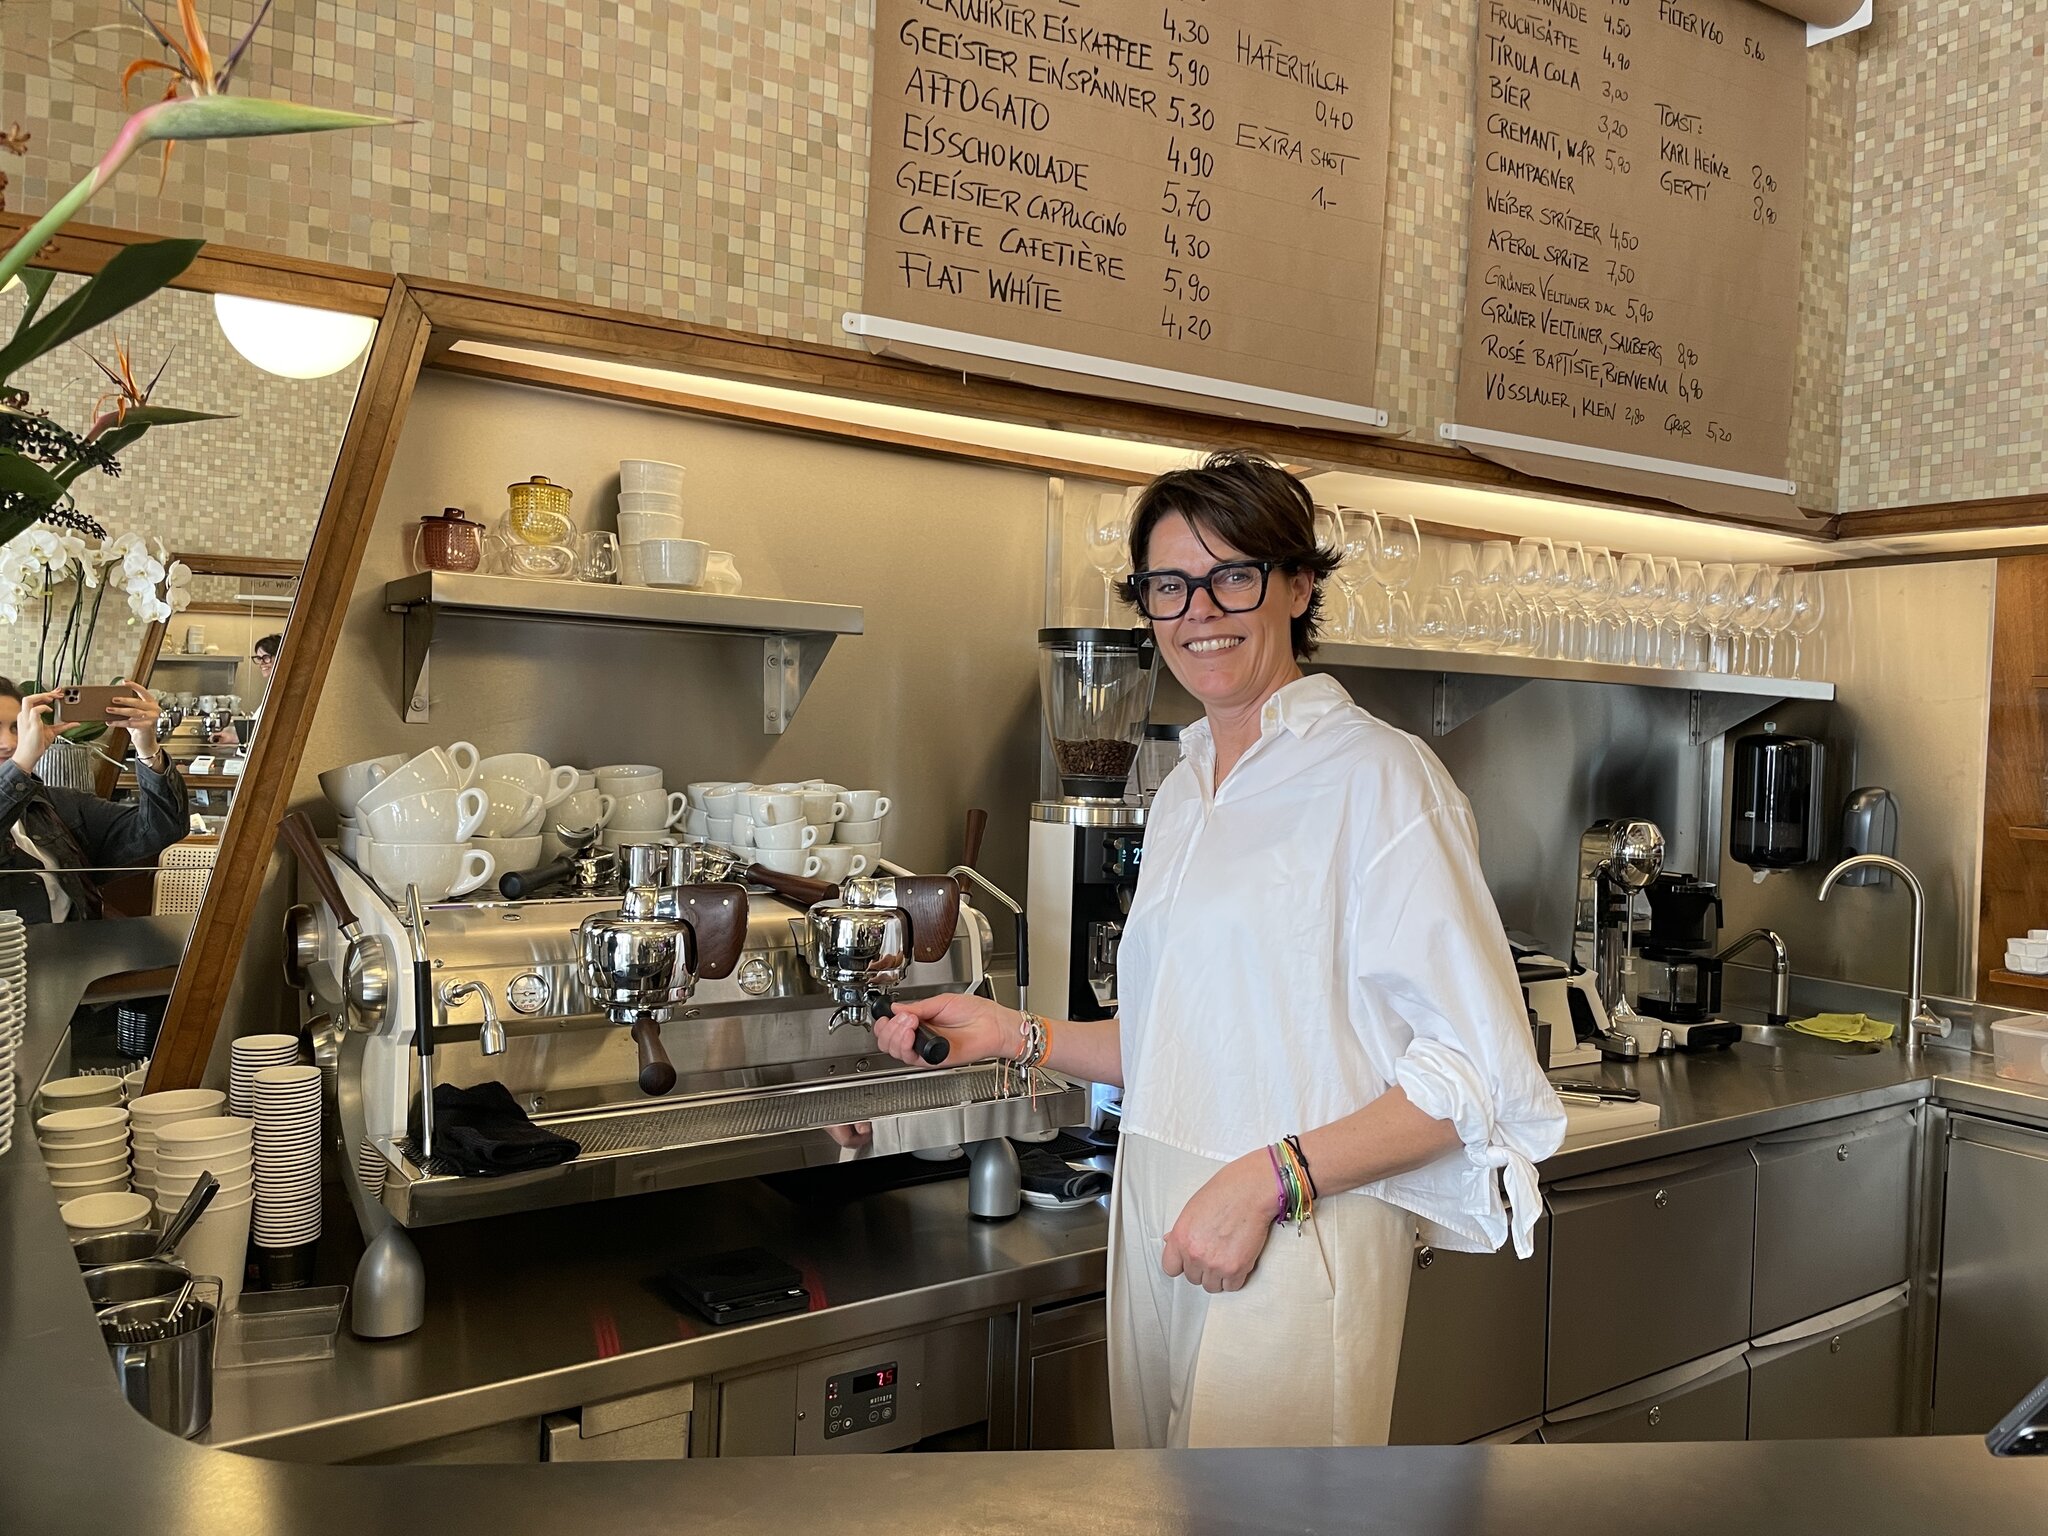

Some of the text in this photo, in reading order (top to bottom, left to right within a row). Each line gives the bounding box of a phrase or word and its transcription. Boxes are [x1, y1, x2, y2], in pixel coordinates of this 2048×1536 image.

[1043, 14, 1154, 71] EISKAFFEE
[1168, 51, 1210, 86] 5,90
[1163, 8, 1209, 45] 4,30
[1658, 0, 1698, 35] FILTER
[1700, 18, 1724, 45] V60
[899, 19, 1017, 78] GEEISTER
[1167, 96, 1215, 131] 5,30
[1237, 29, 1349, 95] HAFERMILCH
[1485, 35, 1539, 80] TIROLA
[1544, 62, 1581, 91] COLA
[905, 66, 1214, 178] AFFOGATO 4,90
[1315, 100, 1353, 130] 0,40
[1489, 76, 1628, 140] BIER 3,20
[903, 112, 1211, 221] EISSCHOKOLADE 5,70
[1235, 123, 1360, 176] EXTRA SHOT
[1486, 151, 1576, 195] CHAMPAGNER
[1605, 149, 1631, 175] 5,90
[1660, 136, 1777, 193] KARL HEINZ 8,90
[896, 161, 1210, 259] GEEISTER CAPPUCCINO 4,30
[1660, 170, 1777, 225] GERTI 8,90
[1488, 229, 1635, 286] APEROL SPRITZ 7,50
[1539, 208, 1602, 246] SPRITZER
[1610, 223, 1639, 251] 4,50
[999, 228, 1126, 281] CAFETIÈRE
[1164, 268, 1210, 301] 5,90
[896, 251, 1211, 341] FLAT WHITE 4,20
[1484, 265, 1654, 324] GRÜNER VELTLINER DAC 5,90
[1481, 297, 1536, 329] GRÜNER
[1677, 343, 1698, 370] 8,90
[1481, 334, 1527, 365] ROSÉ
[1678, 373, 1704, 403] 6,90
[1582, 397, 1617, 421] KLEIN
[1625, 407, 1646, 426] 2,80
[1705, 421, 1732, 443] 5,20
